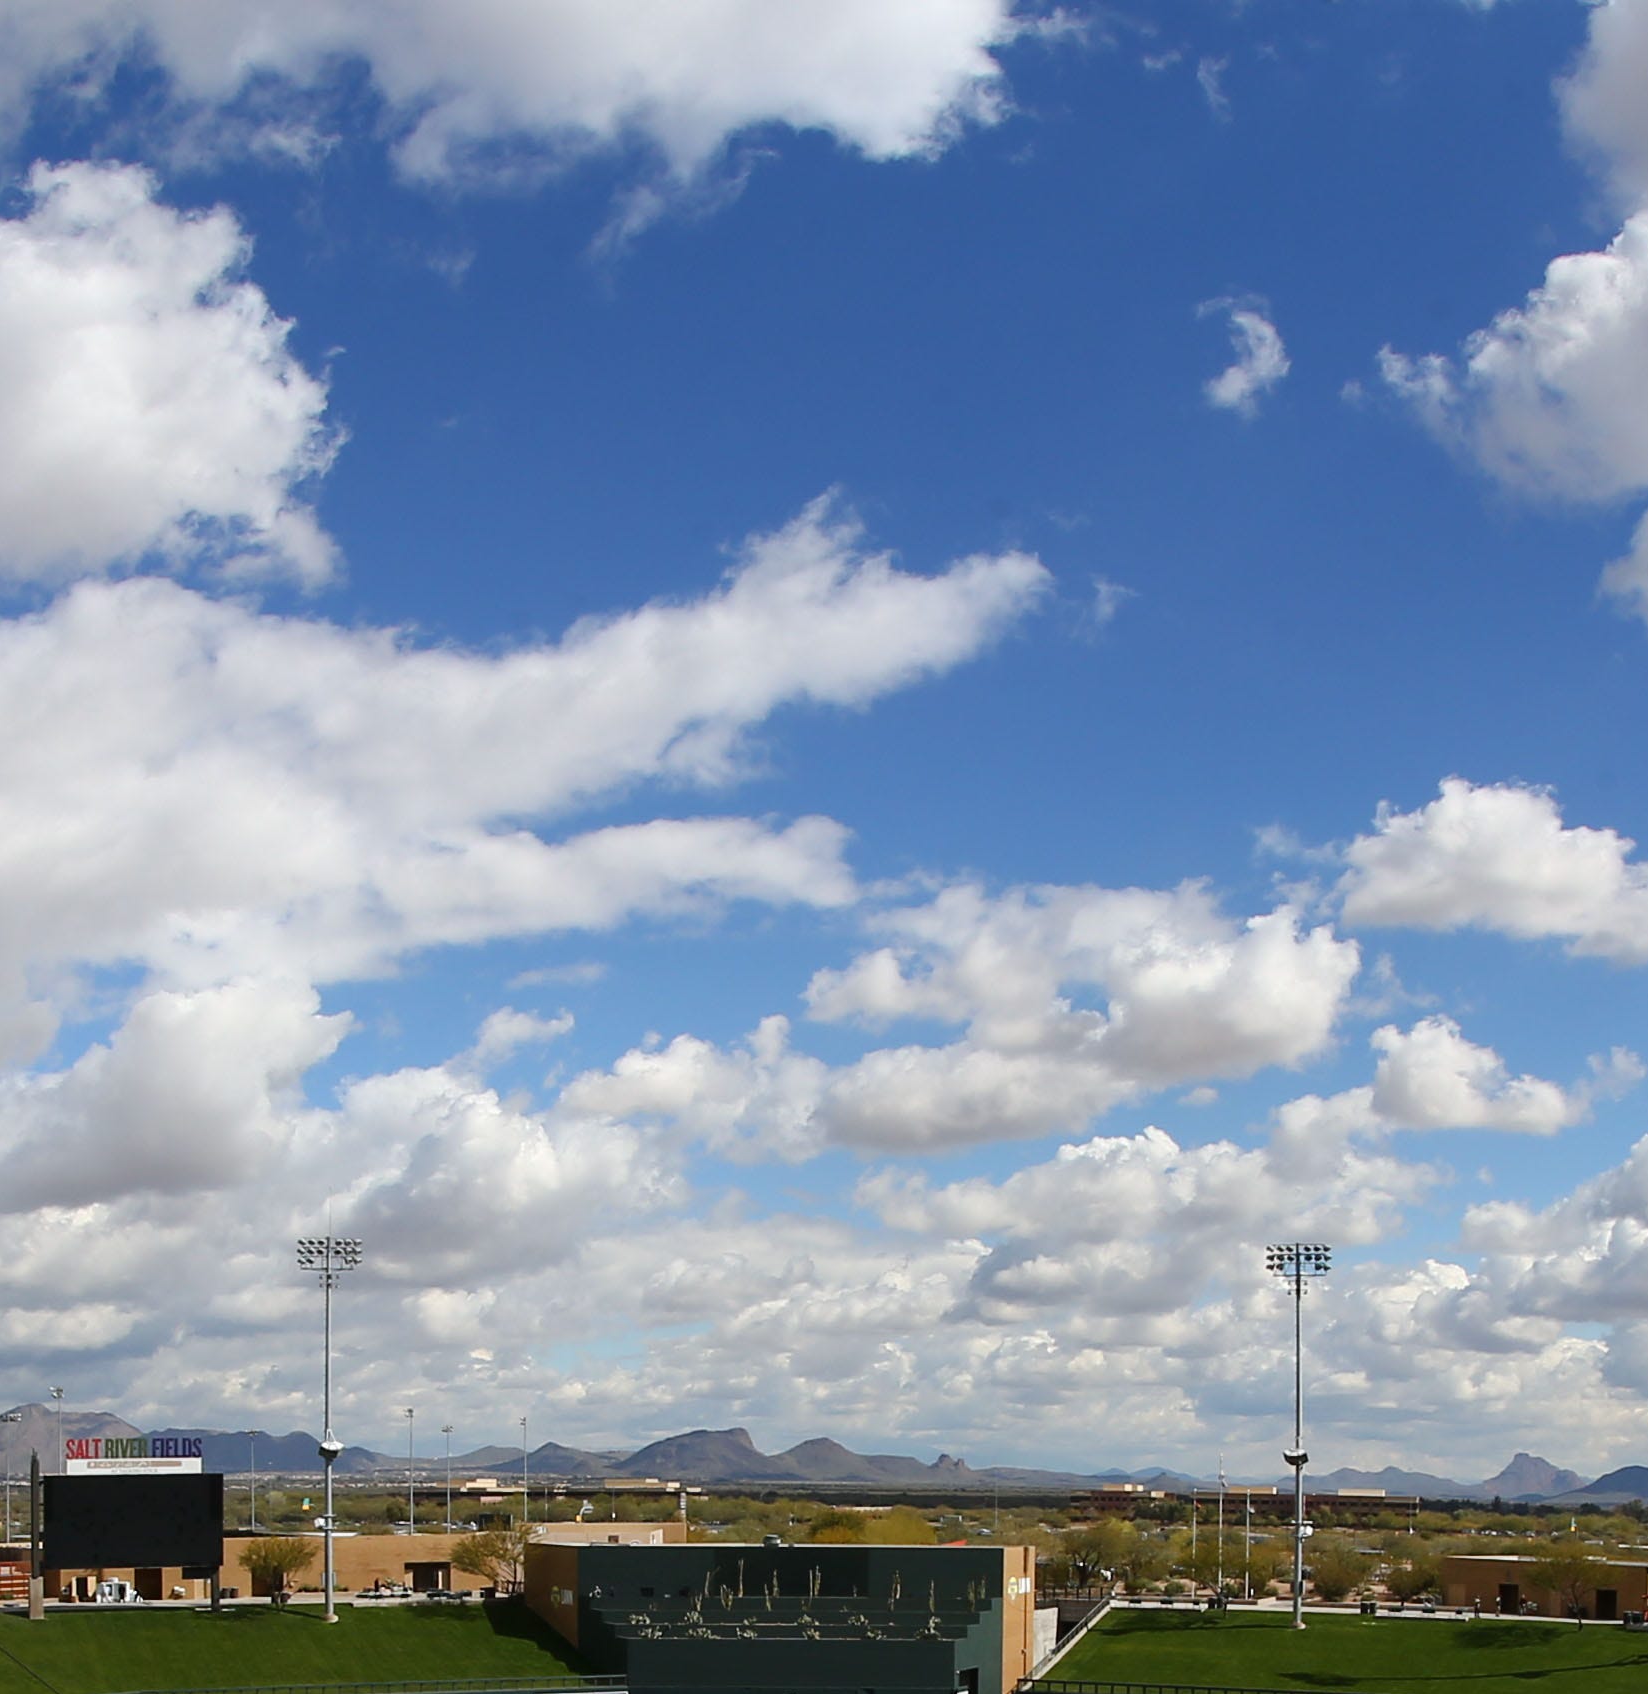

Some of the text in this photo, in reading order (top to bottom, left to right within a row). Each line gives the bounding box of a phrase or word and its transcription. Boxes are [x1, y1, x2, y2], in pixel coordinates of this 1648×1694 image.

[66, 1438, 202, 1459] SALT RIVER FIELDS
